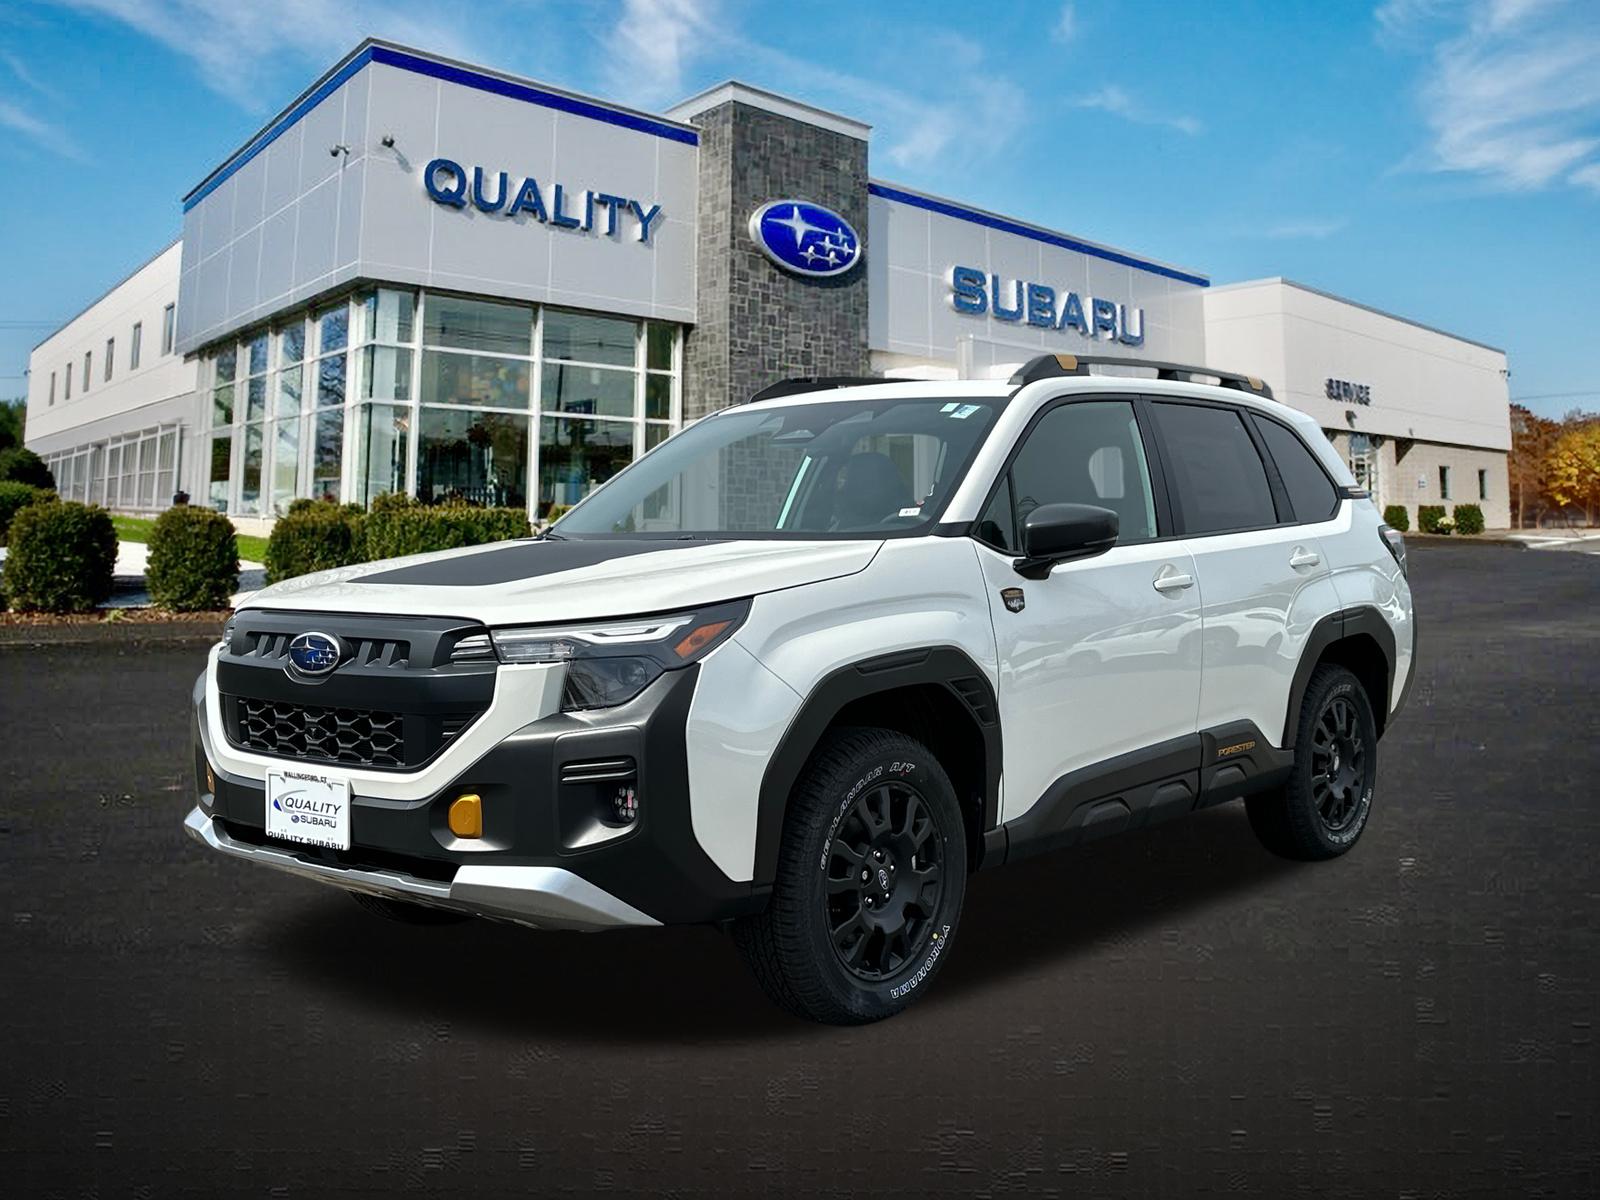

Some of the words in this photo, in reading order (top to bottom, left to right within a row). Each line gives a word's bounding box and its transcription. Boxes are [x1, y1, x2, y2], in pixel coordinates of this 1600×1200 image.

[424, 158, 661, 242] QUALITY
[951, 265, 1145, 346] SUBARU
[1325, 378, 1371, 407] SERVICE
[285, 797, 342, 815] QUALITY
[300, 814, 337, 829] SUBARU
[267, 830, 304, 843] QUALITY
[306, 837, 344, 851] SUBARU
[890, 924, 951, 999] YOKOHAMA
